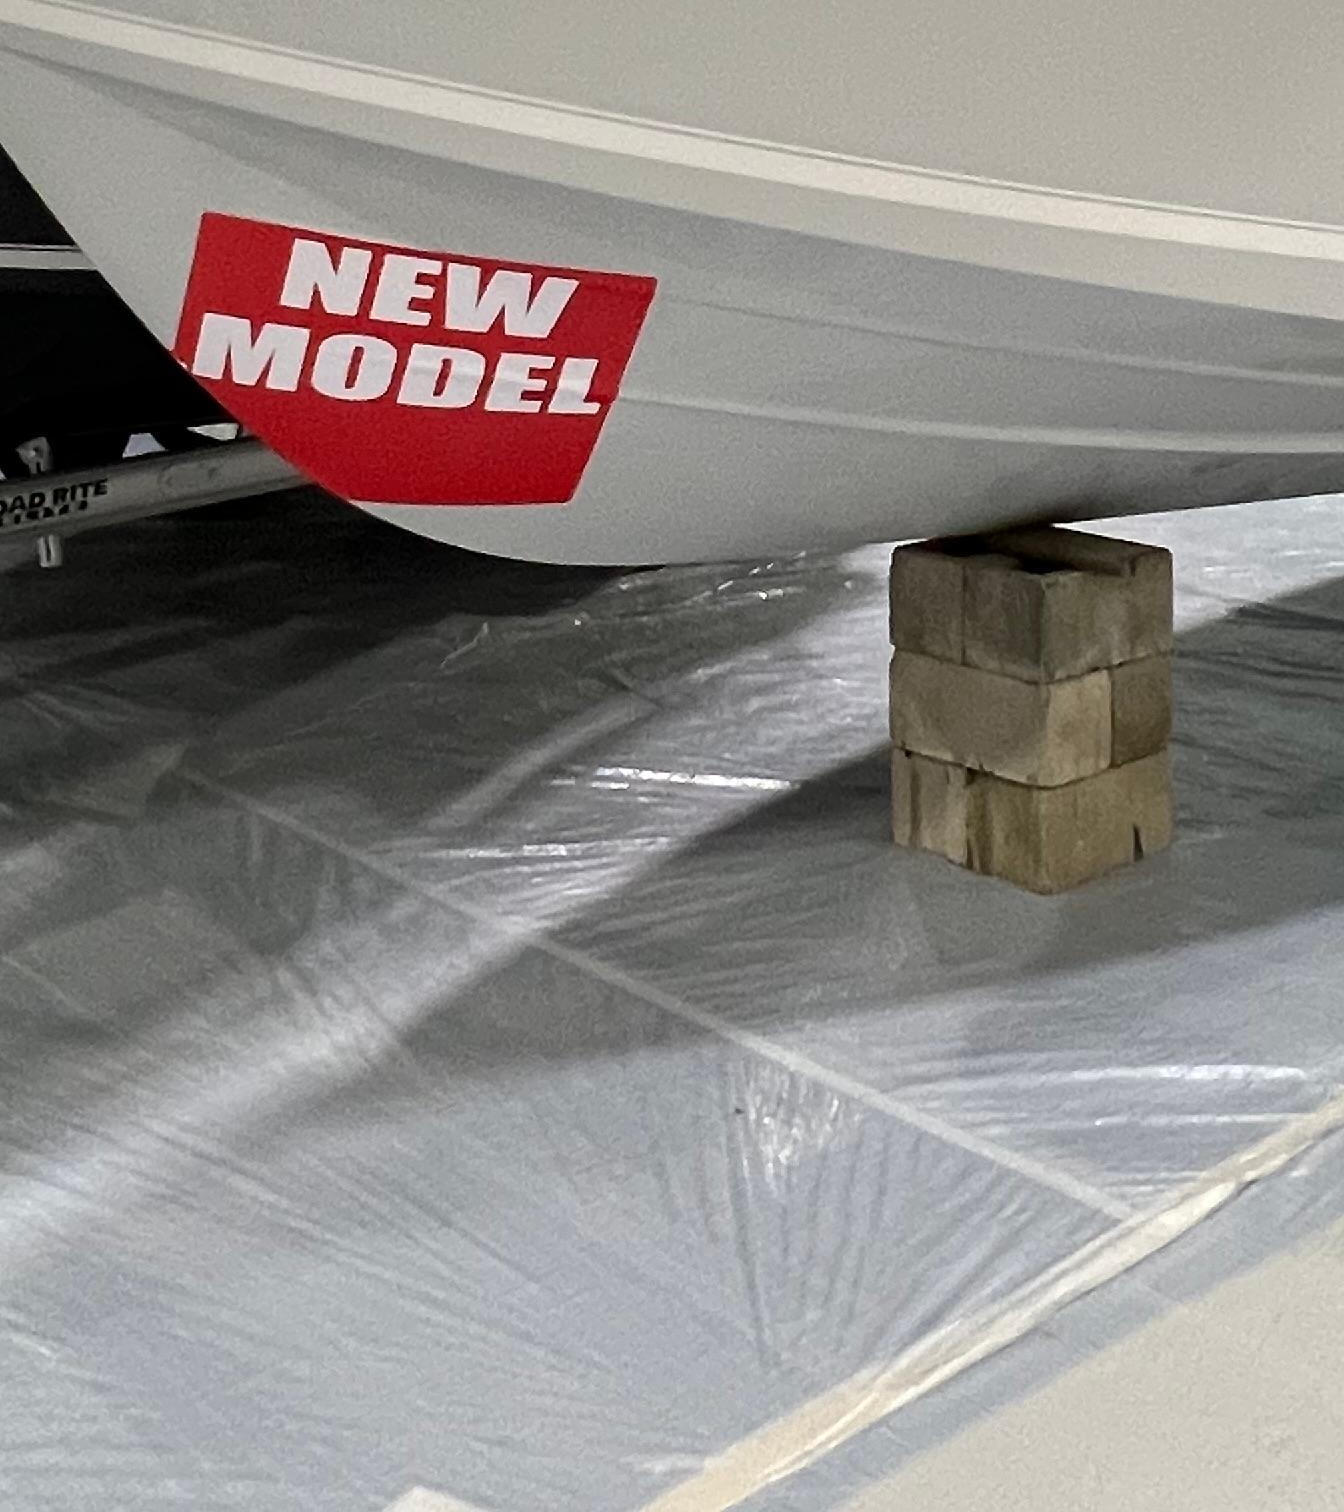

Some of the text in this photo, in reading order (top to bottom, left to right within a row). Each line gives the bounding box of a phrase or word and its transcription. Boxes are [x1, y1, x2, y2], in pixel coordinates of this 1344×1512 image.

[280, 238, 579, 338] NEW
[193, 313, 601, 414] MODEL
[52, 479, 108, 506] RITE
